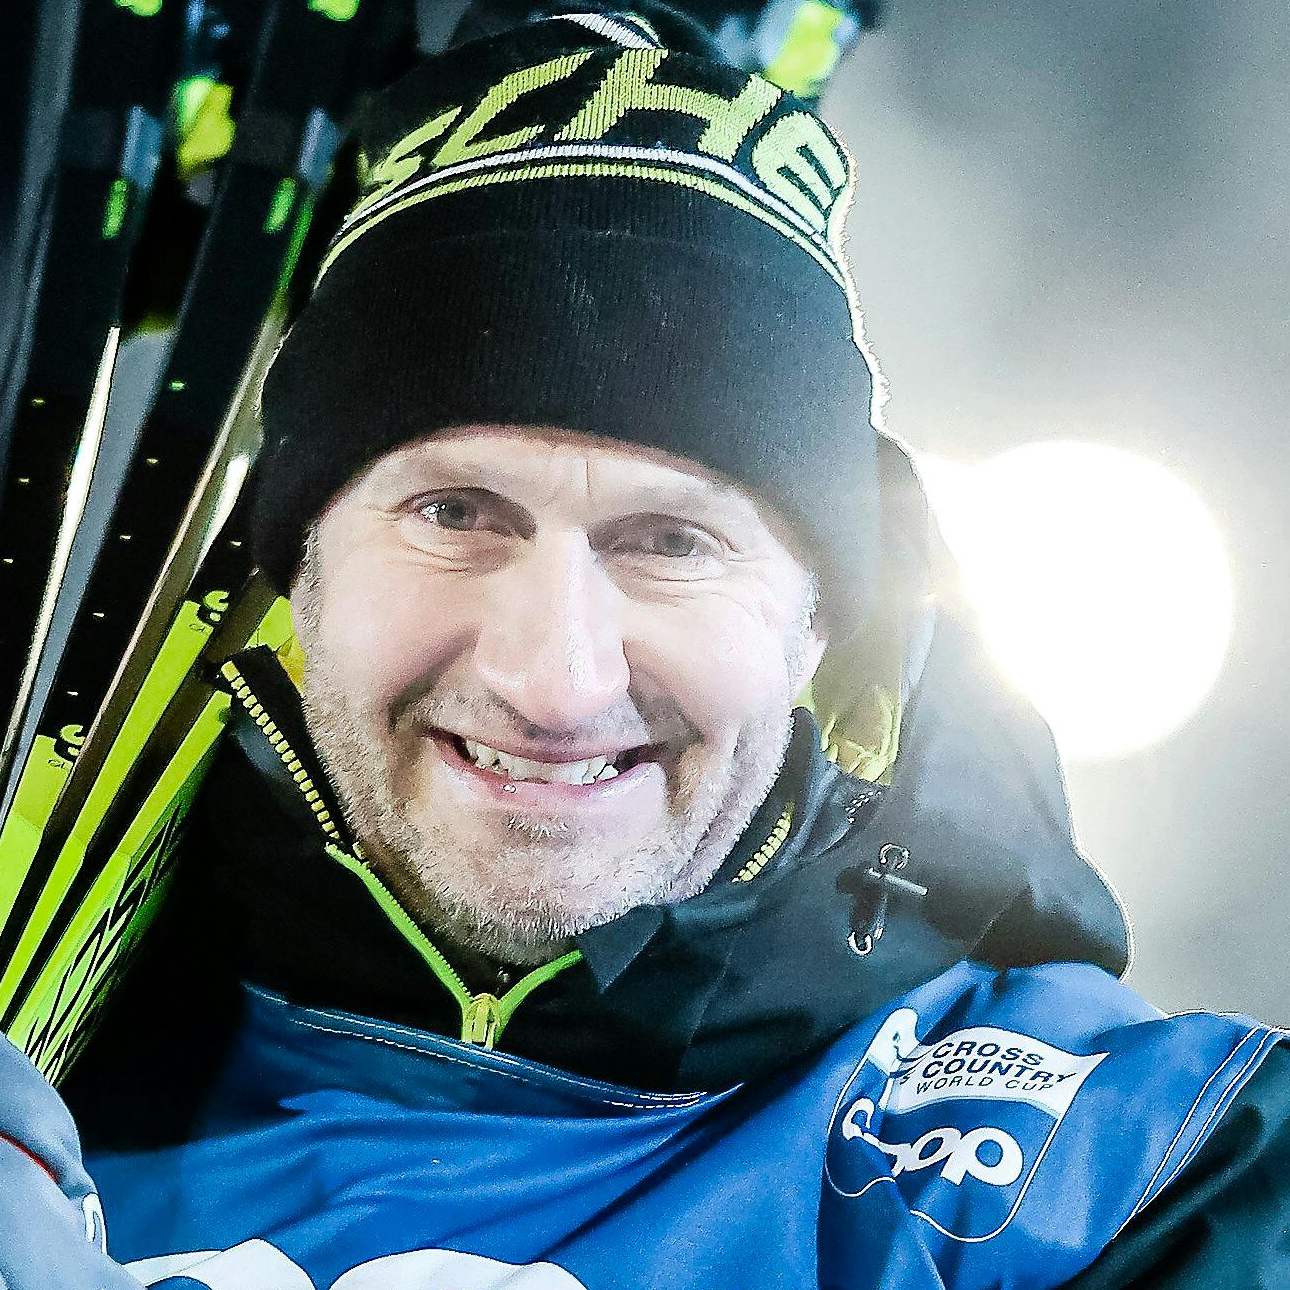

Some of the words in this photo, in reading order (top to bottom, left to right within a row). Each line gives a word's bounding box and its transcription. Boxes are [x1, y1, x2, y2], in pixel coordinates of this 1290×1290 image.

[932, 1041, 1042, 1067] CROSS
[922, 1060, 1077, 1083] COUNTRY
[915, 1075, 993, 1095] WORLD
[1004, 1079, 1054, 1092] CUP
